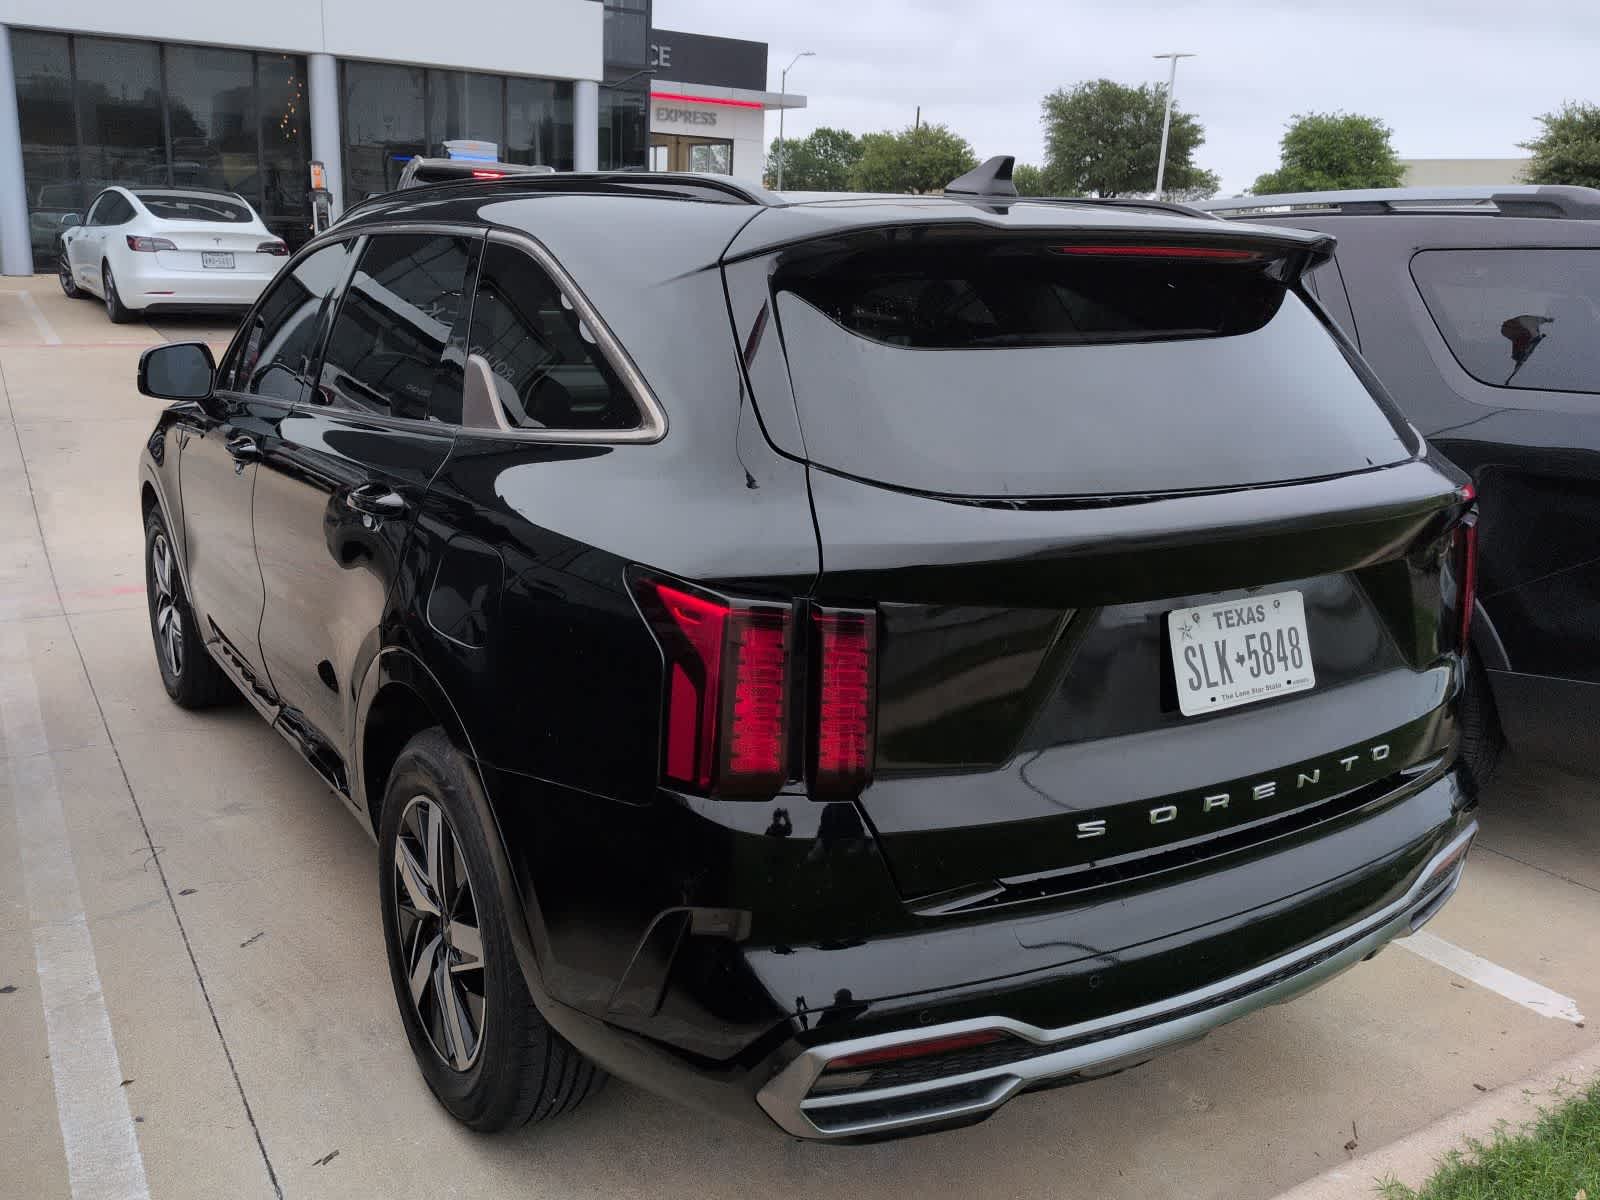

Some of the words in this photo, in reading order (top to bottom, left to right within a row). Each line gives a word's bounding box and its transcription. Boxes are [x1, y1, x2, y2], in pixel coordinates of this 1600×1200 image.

[656, 107, 718, 126] EXPRESS
[1213, 604, 1266, 630] TEXAS
[1235, 690, 1250, 698] Lone
[1265, 683, 1282, 691] State
[1076, 744, 1390, 839] SORENTO
